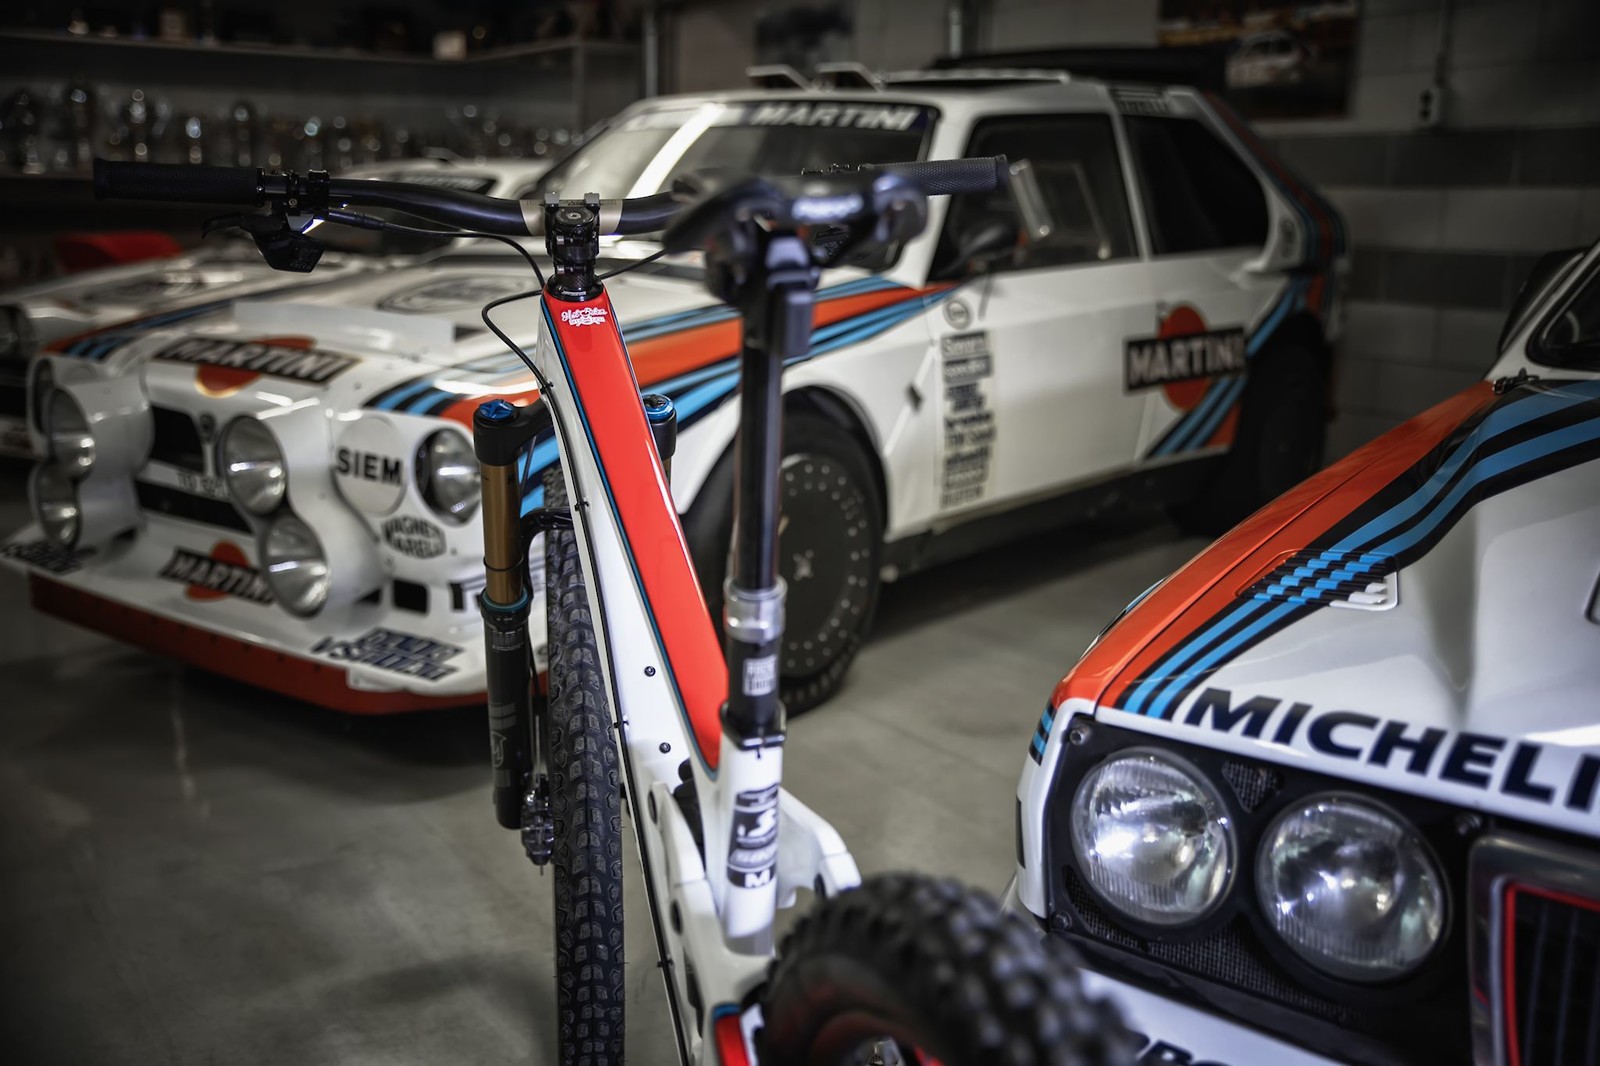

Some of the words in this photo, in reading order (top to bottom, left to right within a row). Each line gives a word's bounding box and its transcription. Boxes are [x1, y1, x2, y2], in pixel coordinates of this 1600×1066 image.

[751, 103, 921, 131] MARTINI
[162, 340, 351, 380] MARTINI
[1129, 335, 1245, 385] MARTINI
[336, 447, 402, 486] SIEM
[163, 555, 275, 602] MARTIN
